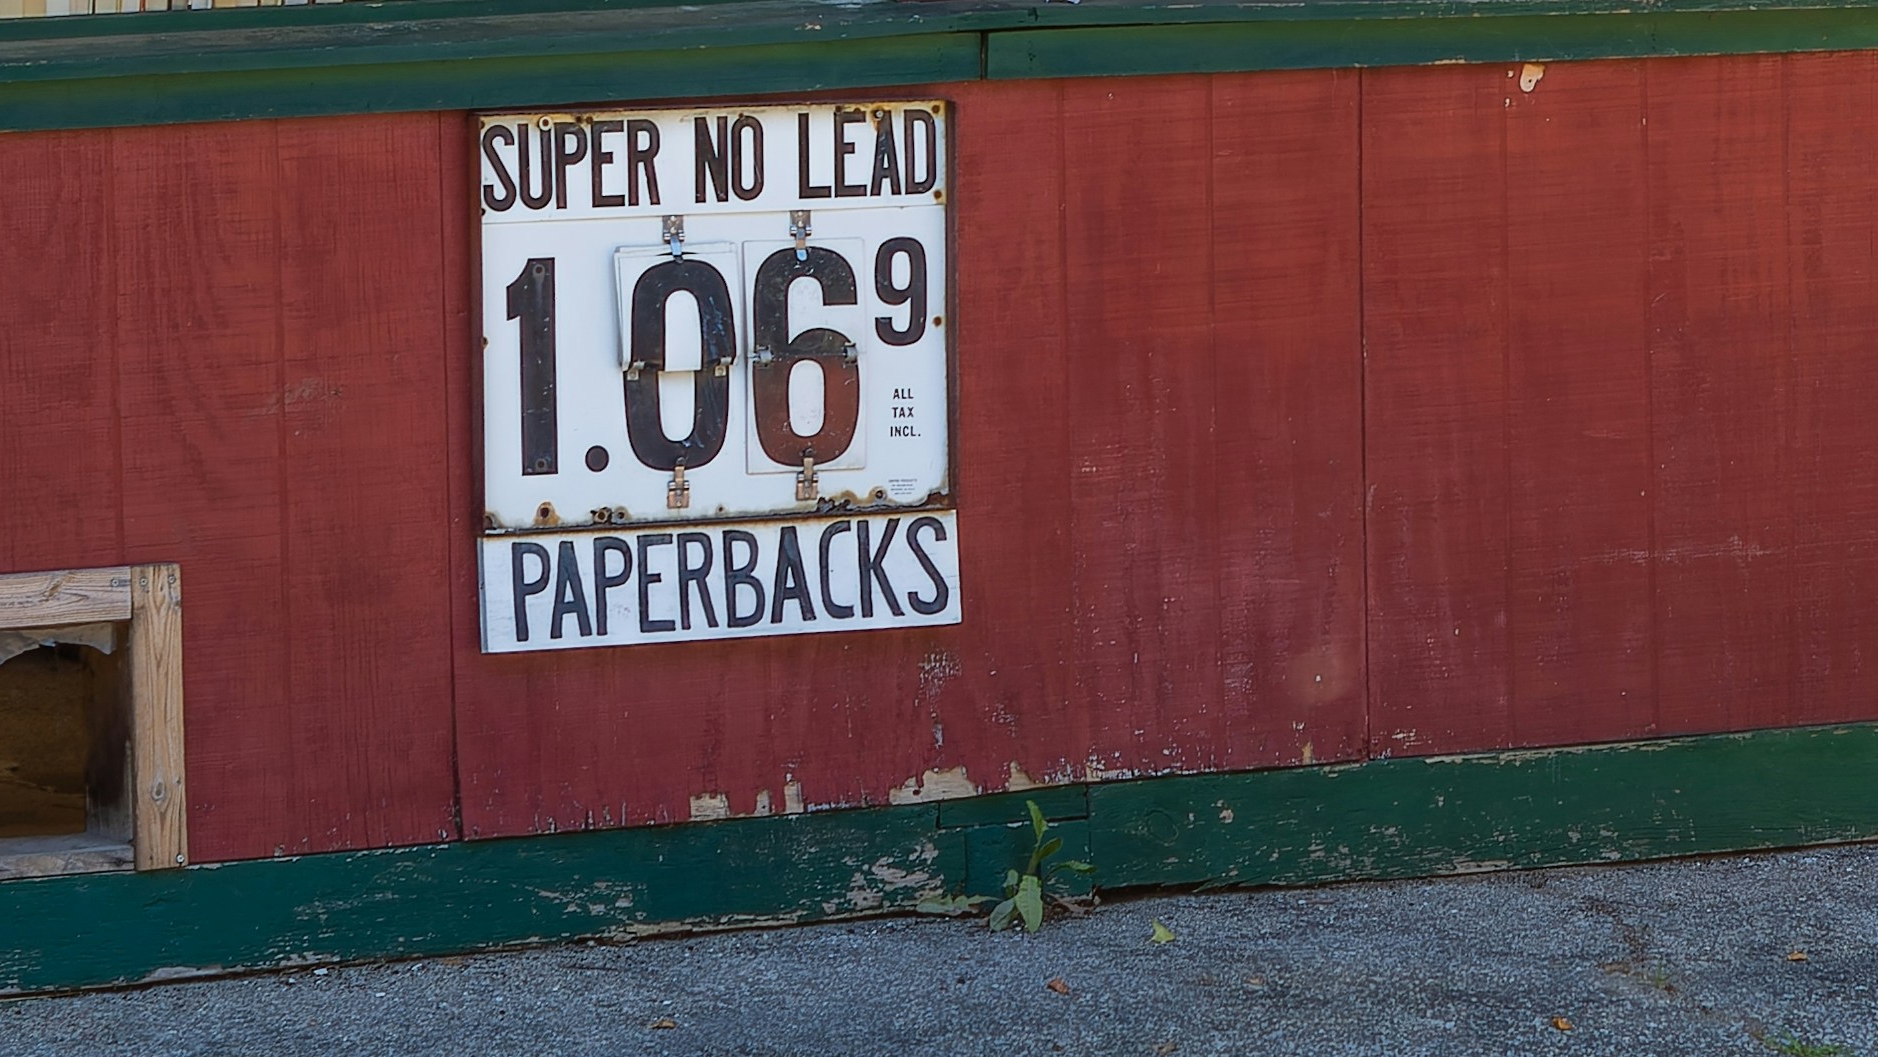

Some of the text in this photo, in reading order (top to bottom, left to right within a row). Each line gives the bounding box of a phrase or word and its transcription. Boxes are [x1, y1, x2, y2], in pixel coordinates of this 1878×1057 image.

[482, 109, 938, 213] SUPER NO LEAD
[892, 388, 915, 401] ALL
[892, 406, 916, 419] TAX
[889, 425, 922, 438] INCL.
[511, 515, 950, 642] PAPERBACKS
